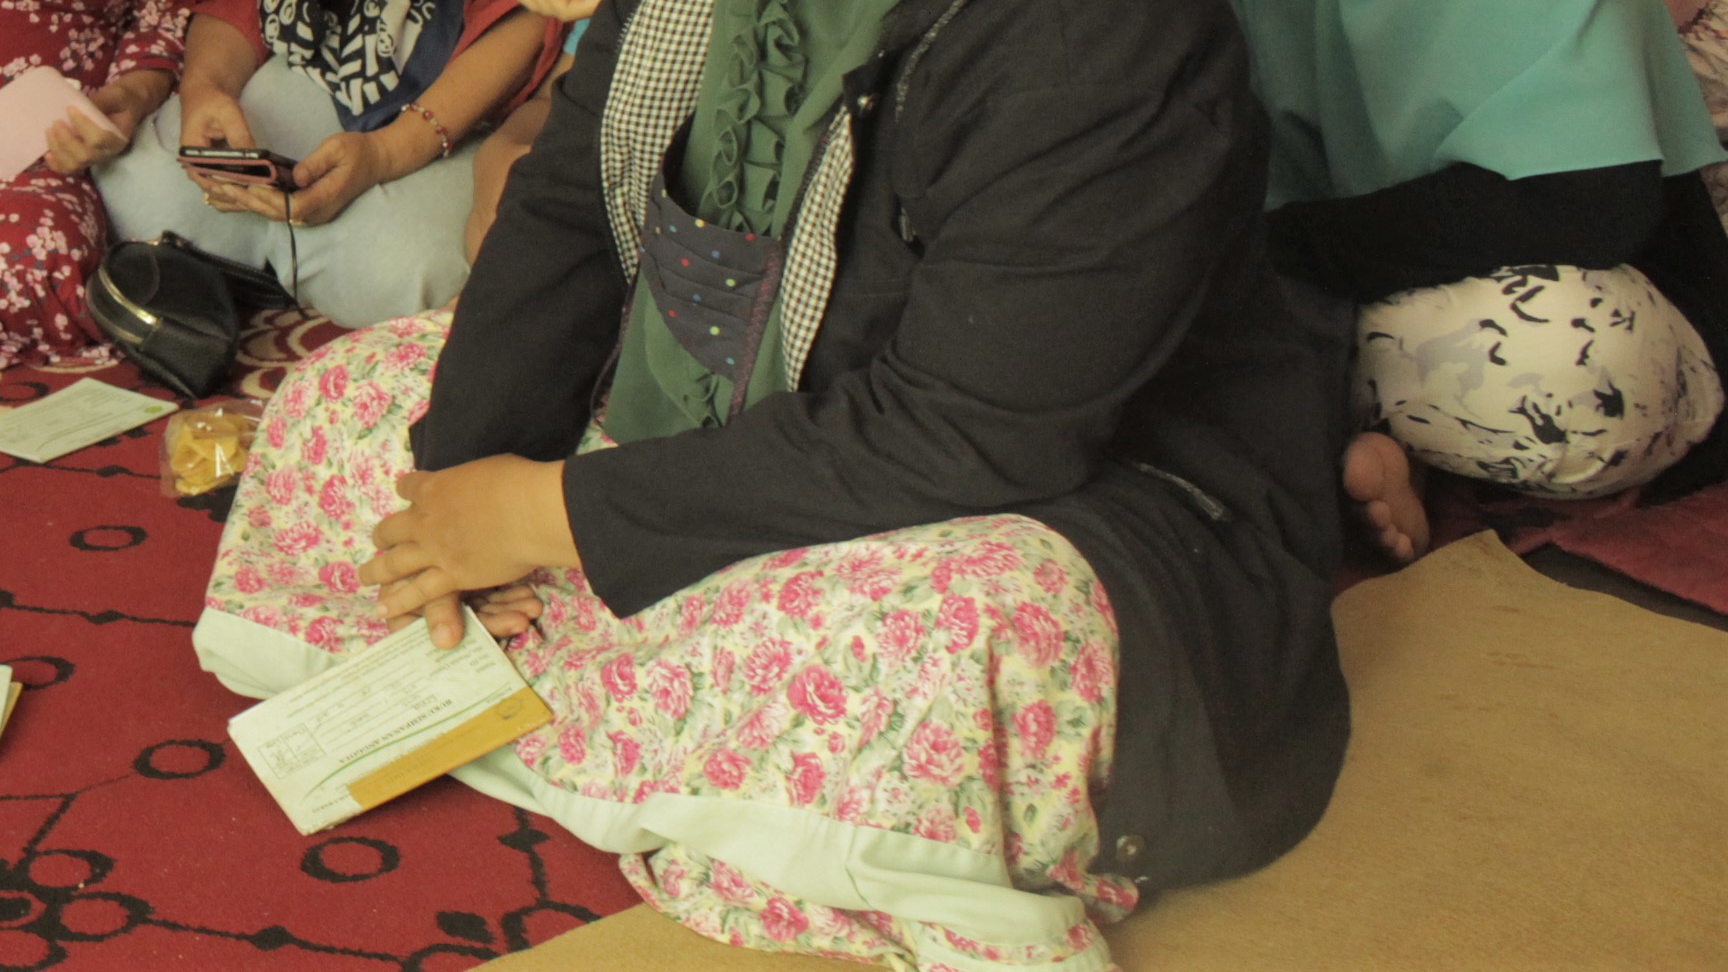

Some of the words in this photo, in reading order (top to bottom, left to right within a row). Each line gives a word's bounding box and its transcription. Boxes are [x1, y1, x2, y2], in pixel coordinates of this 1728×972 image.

[425, 698, 453, 718] BUKU
[379, 712, 428, 742] SIMPANAN
[337, 738, 381, 765] ANGGOTA
